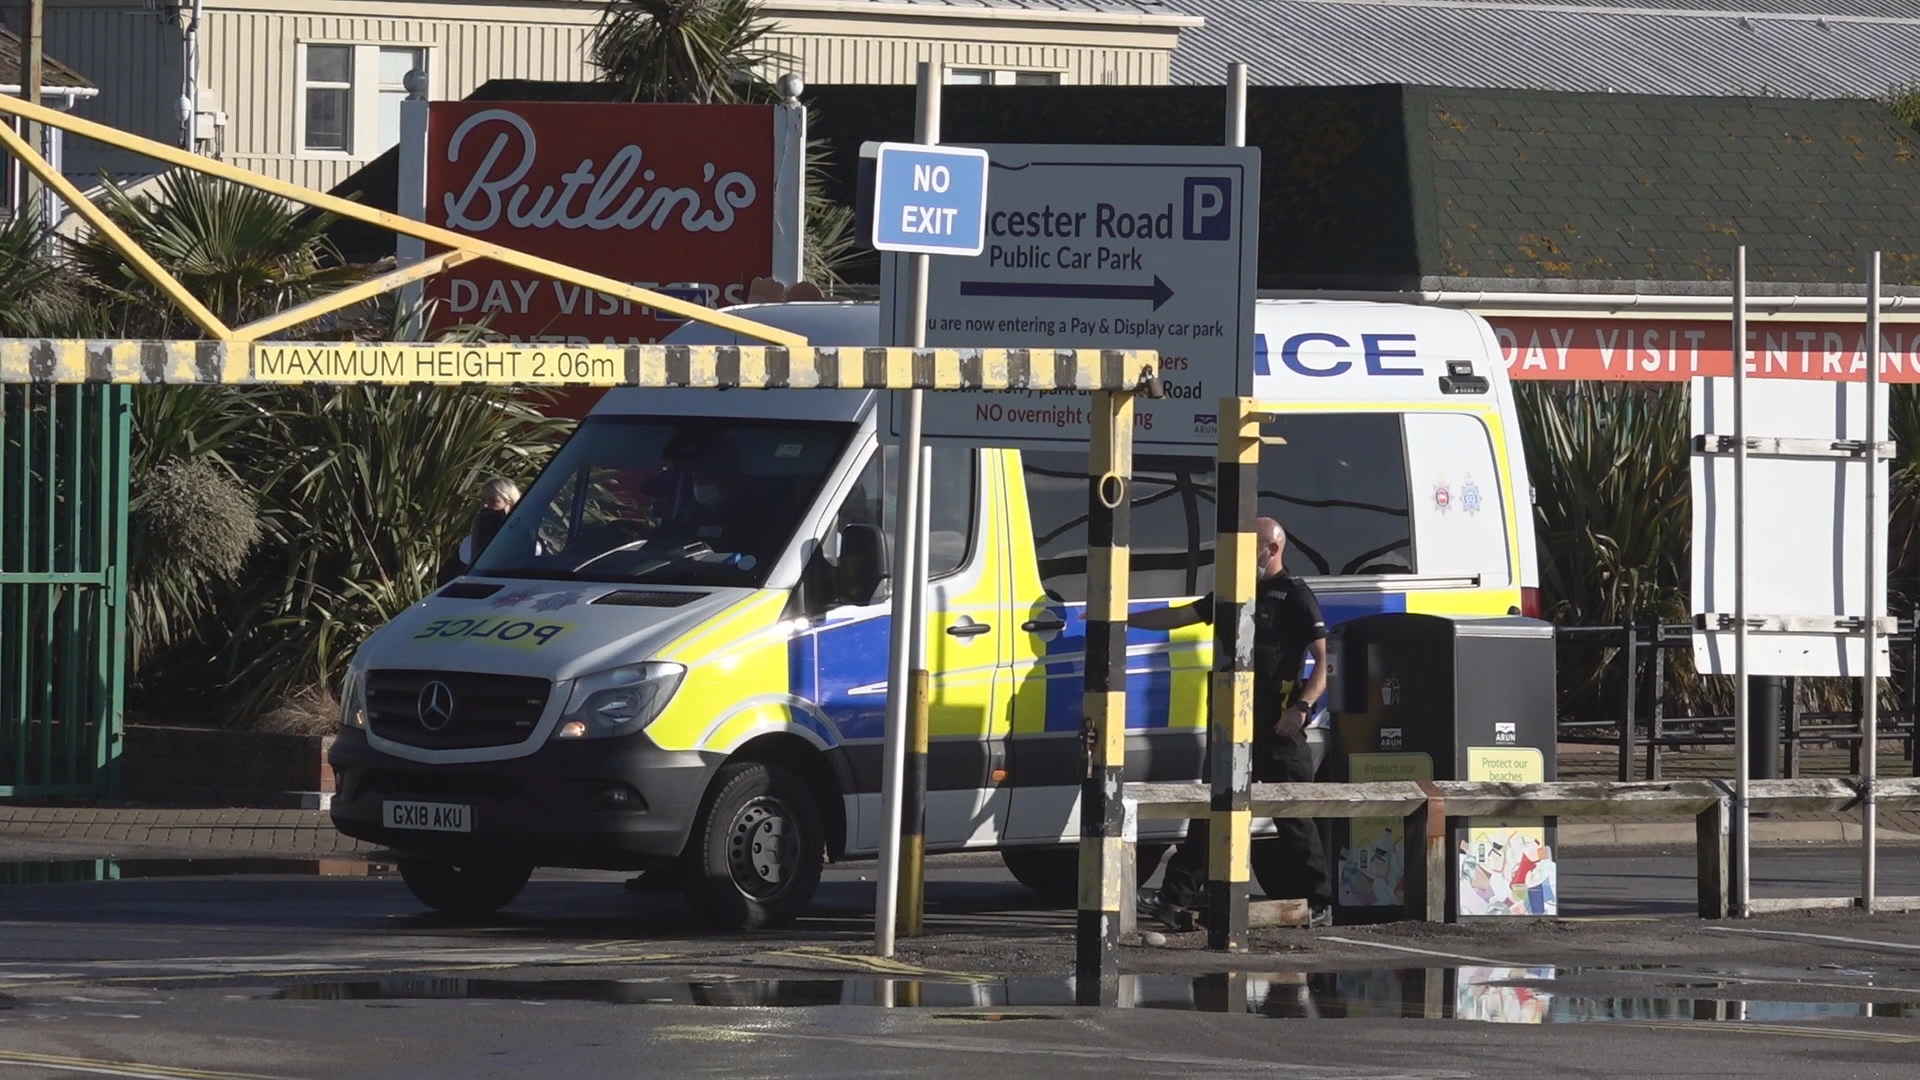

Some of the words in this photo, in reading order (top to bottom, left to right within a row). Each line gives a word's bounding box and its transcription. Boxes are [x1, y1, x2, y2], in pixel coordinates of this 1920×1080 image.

[444, 109, 756, 232] Butlin's
[913, 164, 951, 193] NO
[902, 205, 958, 235] EXIT
[984, 204, 1087, 238] cester
[1096, 203, 1174, 239] Road
[1192, 184, 1224, 234] P
[989, 244, 1051, 269] Public
[1056, 246, 1092, 270] Car
[1097, 246, 1143, 271] Park
[450, 278, 539, 314] DAY
[940, 317, 962, 331] are
[966, 318, 995, 332] now
[998, 315, 1055, 336] entering
[1059, 320, 1067, 333] a
[1071, 317, 1096, 337] Pay
[1099, 318, 1110, 334] &
[1114, 318, 1165, 339] Display
[1168, 322, 1190, 336] car
[1192, 320, 1224, 340] park
[1254, 332, 1425, 378] ICE
[1495, 327, 1575, 371] DAY
[1595, 328, 1706, 372] VISIT
[260, 348, 405, 377] MAXIMUM
[415, 350, 522, 378] HEIGHT
[531, 352, 615, 379] 2.06m
[1162, 380, 1203, 400] Road
[976, 403, 1003, 422] NO
[1007, 405, 1083, 428] overnight
[1193, 425, 1218, 435] ARUN
[1380, 738, 1403, 747] ARUN
[1495, 733, 1516, 742] ARUN
[1364, 763, 1399, 774] Protect
[1400, 764, 1416, 774] our
[1482, 757, 1512, 769] Protect
[1513, 760, 1528, 769] our
[1489, 770, 1523, 782] beaches
[393, 804, 429, 826] GX18
[433, 807, 462, 829] AKU
